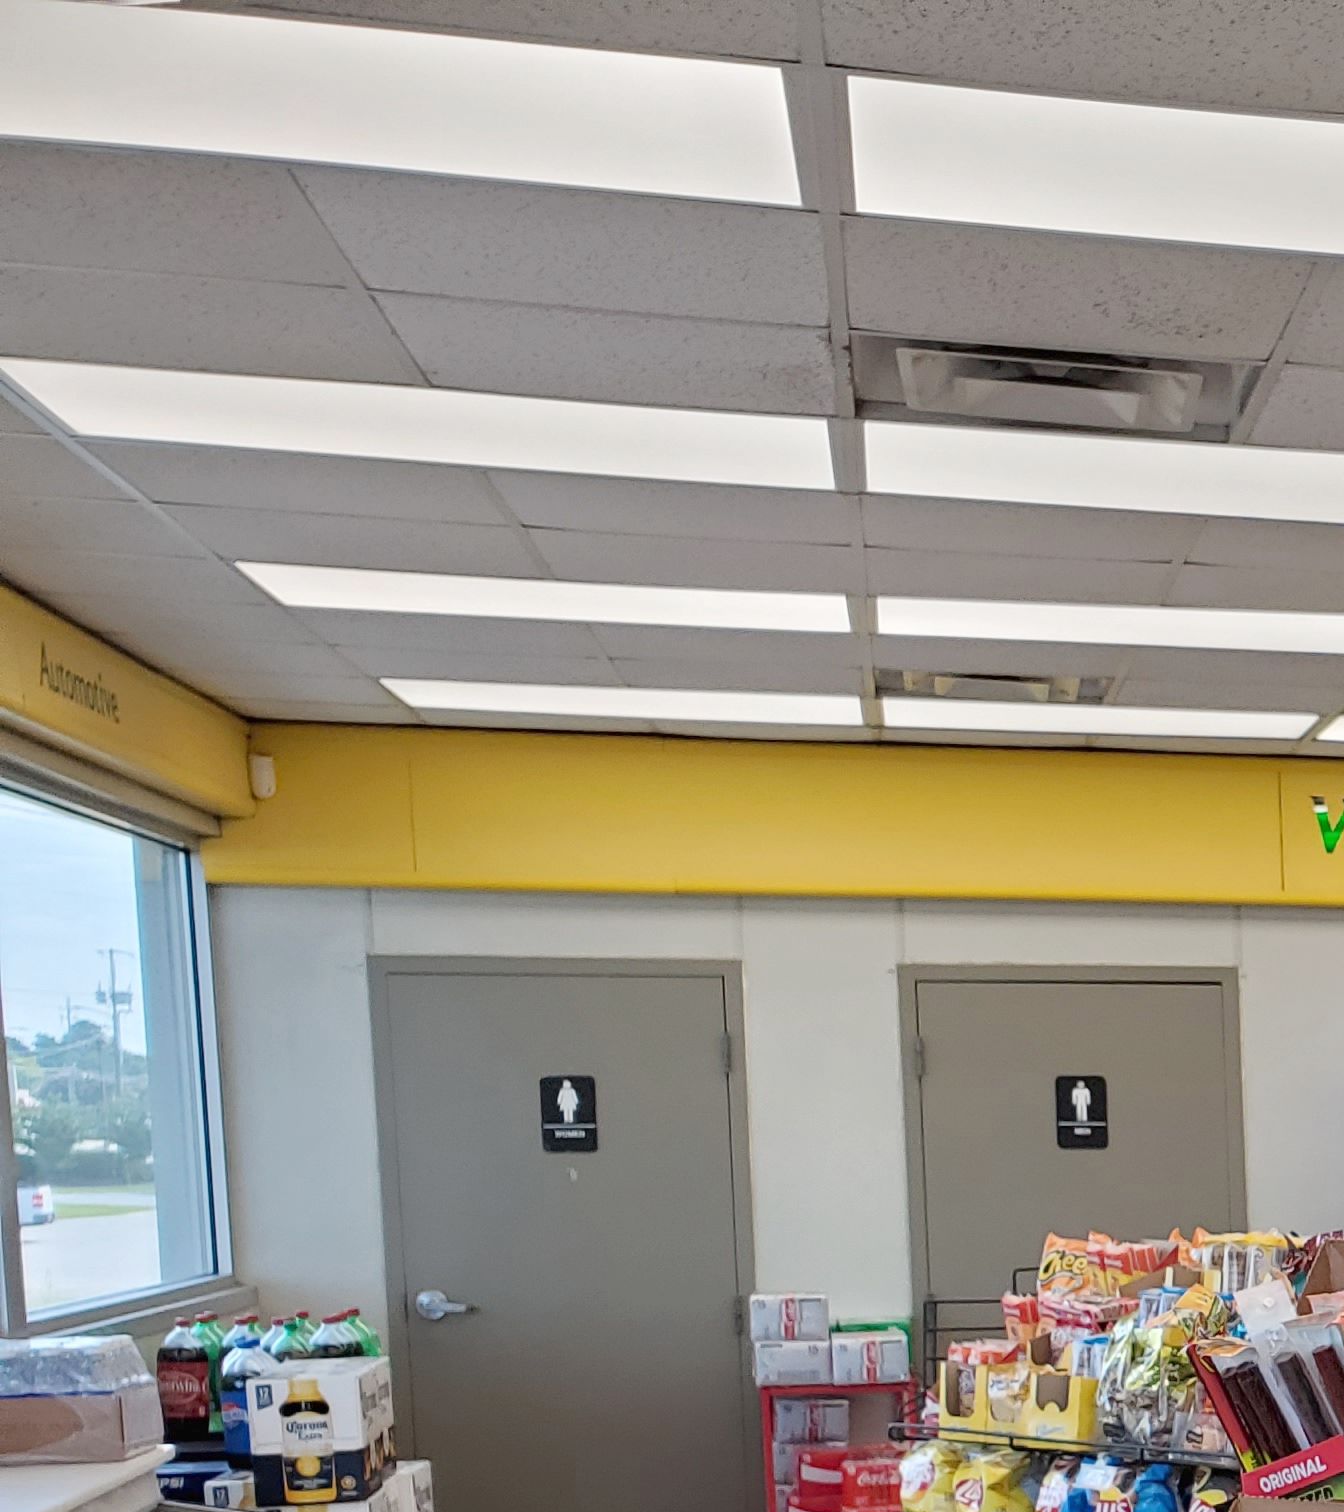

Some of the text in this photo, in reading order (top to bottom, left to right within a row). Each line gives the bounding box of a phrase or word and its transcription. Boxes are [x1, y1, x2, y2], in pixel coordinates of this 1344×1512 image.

[37, 641, 122, 724] Automotive
[286, 1420, 328, 1434] Corona
[1259, 1455, 1327, 1493] ORIGINAL
